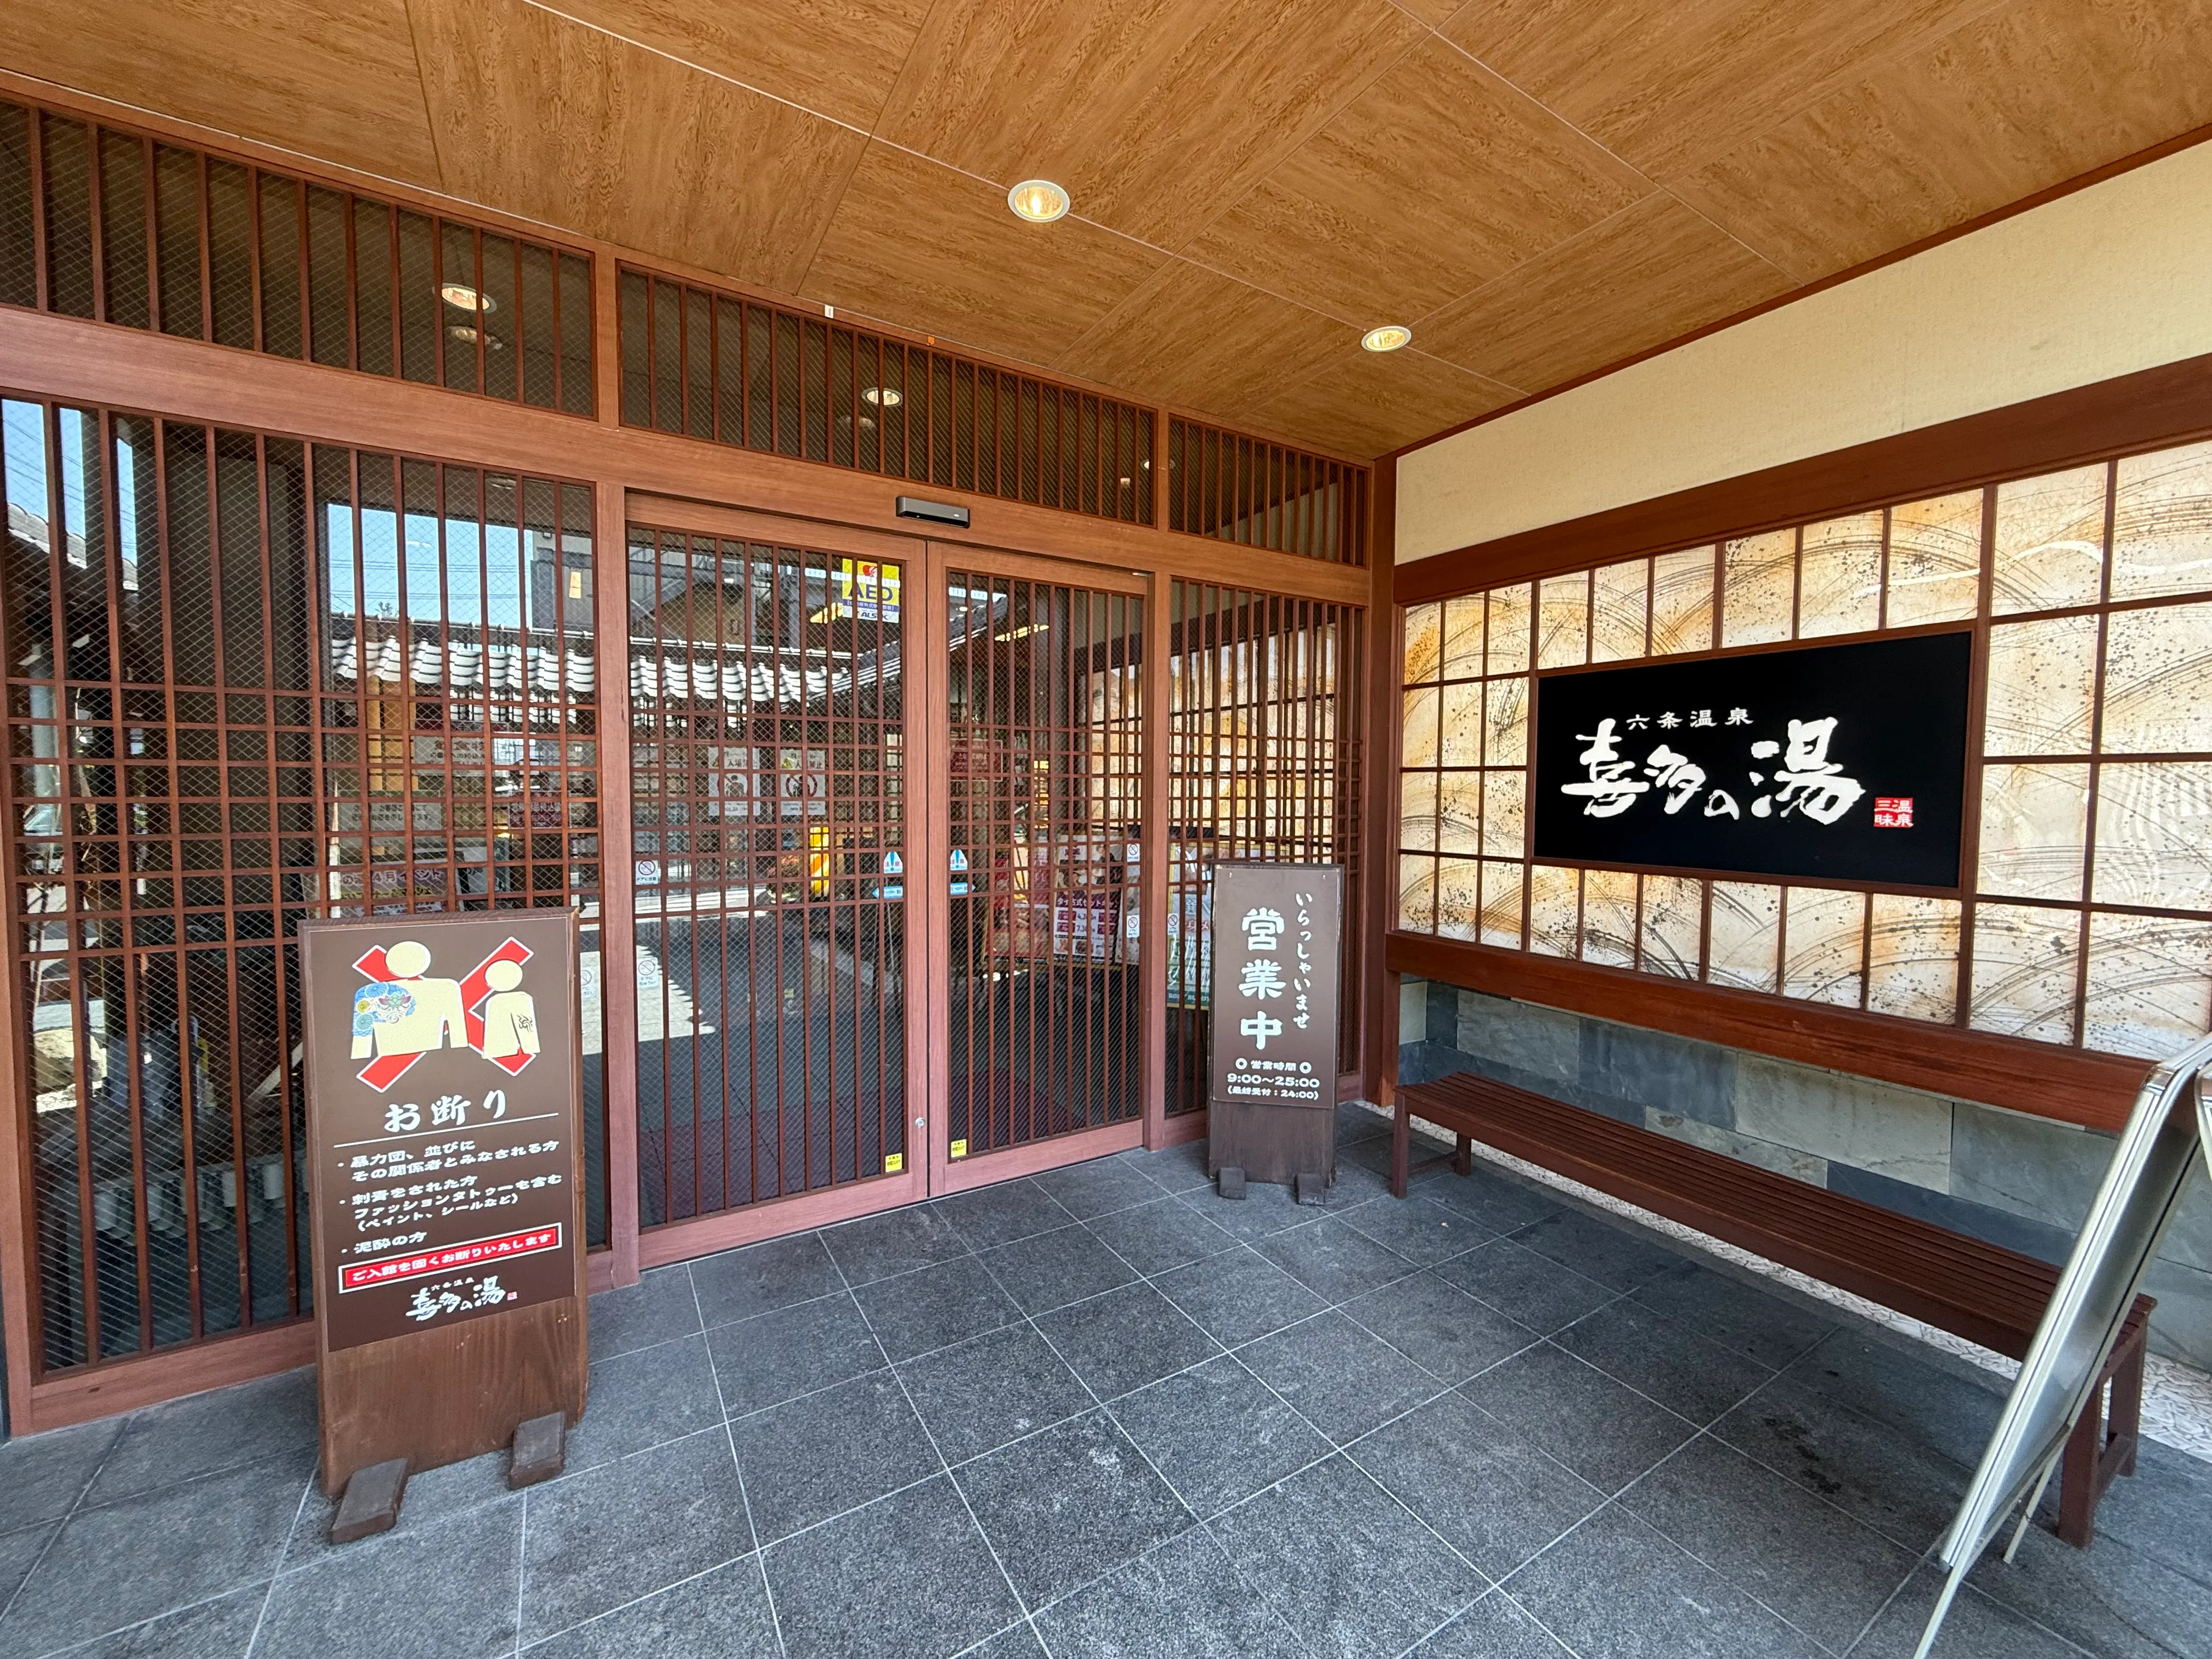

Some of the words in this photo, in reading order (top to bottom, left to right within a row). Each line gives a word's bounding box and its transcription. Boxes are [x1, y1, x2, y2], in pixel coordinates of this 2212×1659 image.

[848, 583, 893, 601] AED
[861, 612, 888, 620] ALSK
[1626, 707, 1754, 730] 六条温泉
[1561, 716, 1866, 826] 喜多の湯
[1238, 907, 1286, 1051] 営業中
[1293, 892, 1313, 1029] いらっしゃいませ
[1227, 1073, 1320, 1088] 9:00～25:00
[1250, 1060, 1296, 1071] 営業時間
[384, 1090, 506, 1133] お断り
[352, 1139, 560, 1182] その関係者とみなされる方
[354, 1173, 562, 1220] ファッションタトゥーも含む
[352, 1233, 552, 1282] ご入館を固くお断りいたします
[405, 1276, 506, 1322] 喜多の湯
